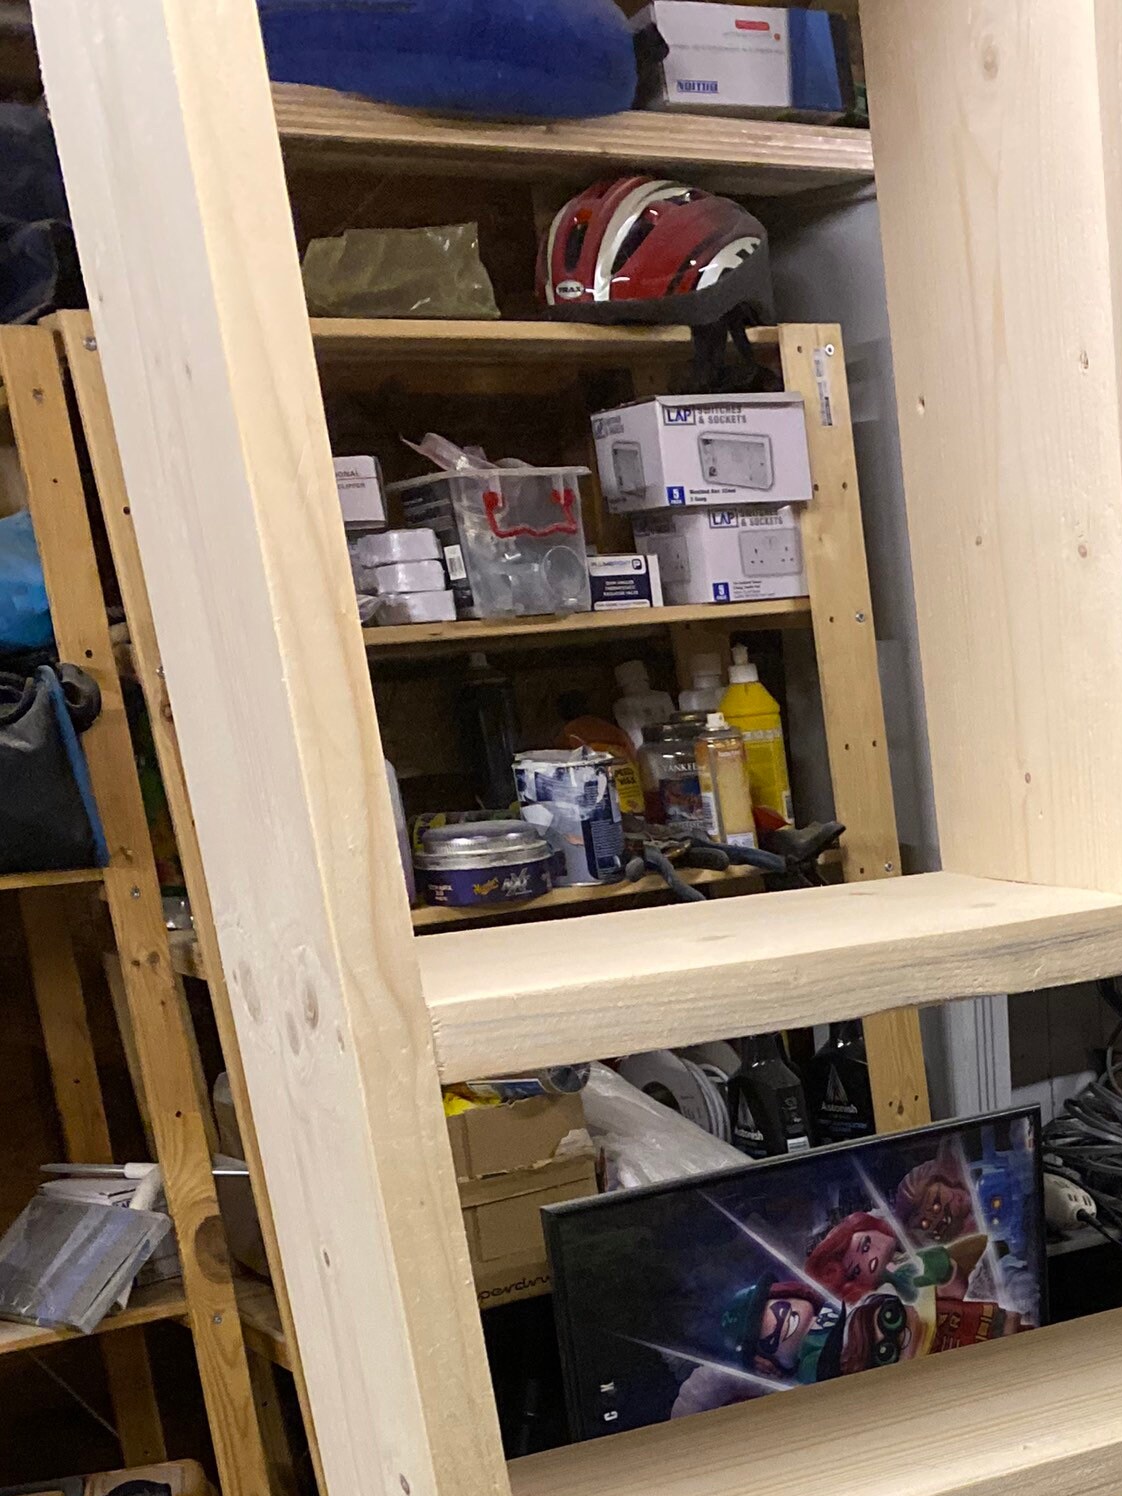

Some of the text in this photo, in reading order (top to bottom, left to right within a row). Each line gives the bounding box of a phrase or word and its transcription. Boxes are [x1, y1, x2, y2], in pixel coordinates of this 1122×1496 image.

[667, 408, 691, 422] LAP
[708, 414, 747, 424] SOCKETS
[713, 512, 735, 525] LAP
